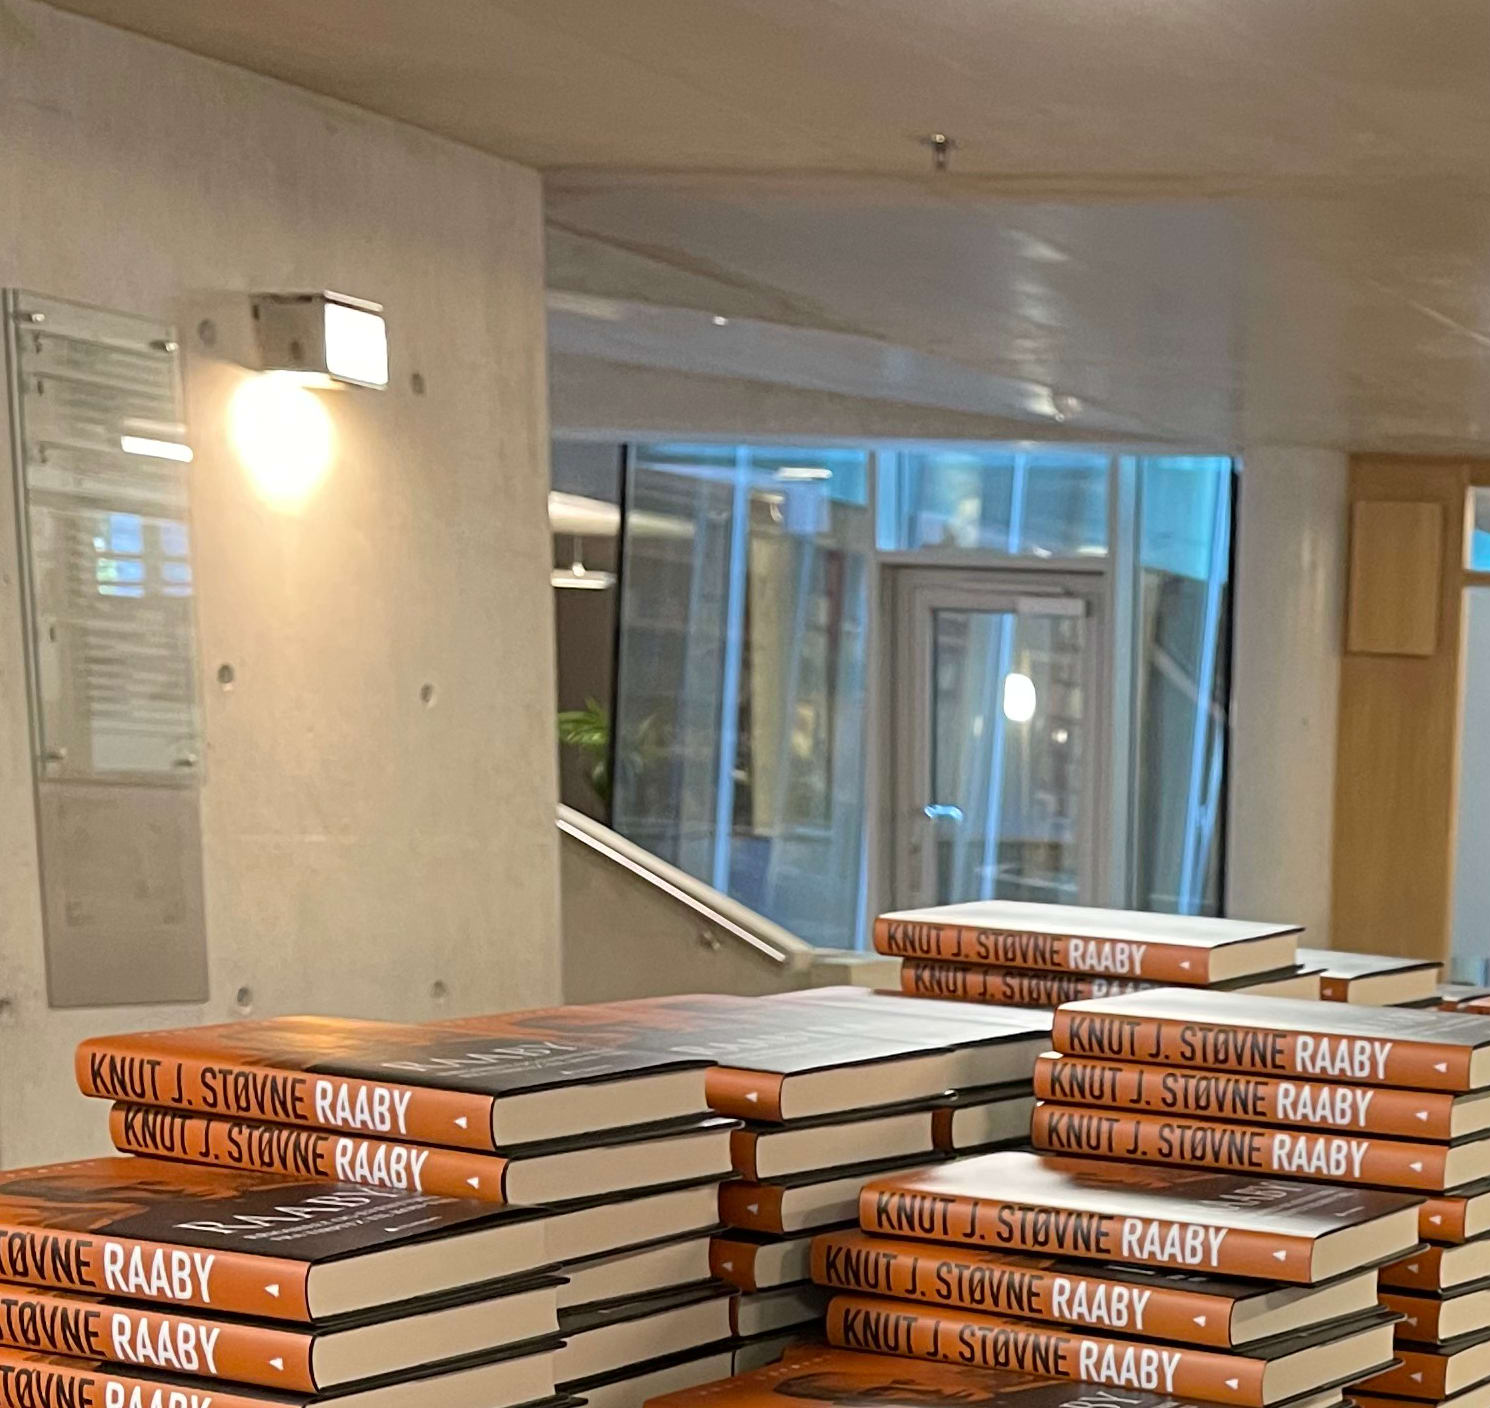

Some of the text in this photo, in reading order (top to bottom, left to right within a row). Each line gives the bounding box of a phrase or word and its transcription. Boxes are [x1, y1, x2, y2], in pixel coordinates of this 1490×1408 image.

[887, 923, 1147, 976] KNUT J. STØVNE RAABY
[914, 964, 970, 996] KNUT
[1069, 1017, 1393, 1080] KNUT J. STØVNE RAABY
[90, 1053, 411, 1135] KNUT J. STØVNE RAABY
[1050, 1063, 1374, 1128] KNUT J. STØVNE RAABY
[124, 1106, 428, 1191] KNUT J. STØVNE RAABY
[1047, 1111, 1369, 1179] KNUT J. STØVNE RAABY
[876, 1191, 1228, 1268] KNUT J. STØVNE RAABY
[104, 1242, 215, 1302] RAABY
[825, 1245, 1151, 1330] KNUT J. STØVNE RAABY
[111, 1313, 220, 1374] RAABY
[843, 1308, 1182, 1393] KNUT J. STØVNE RAABY
